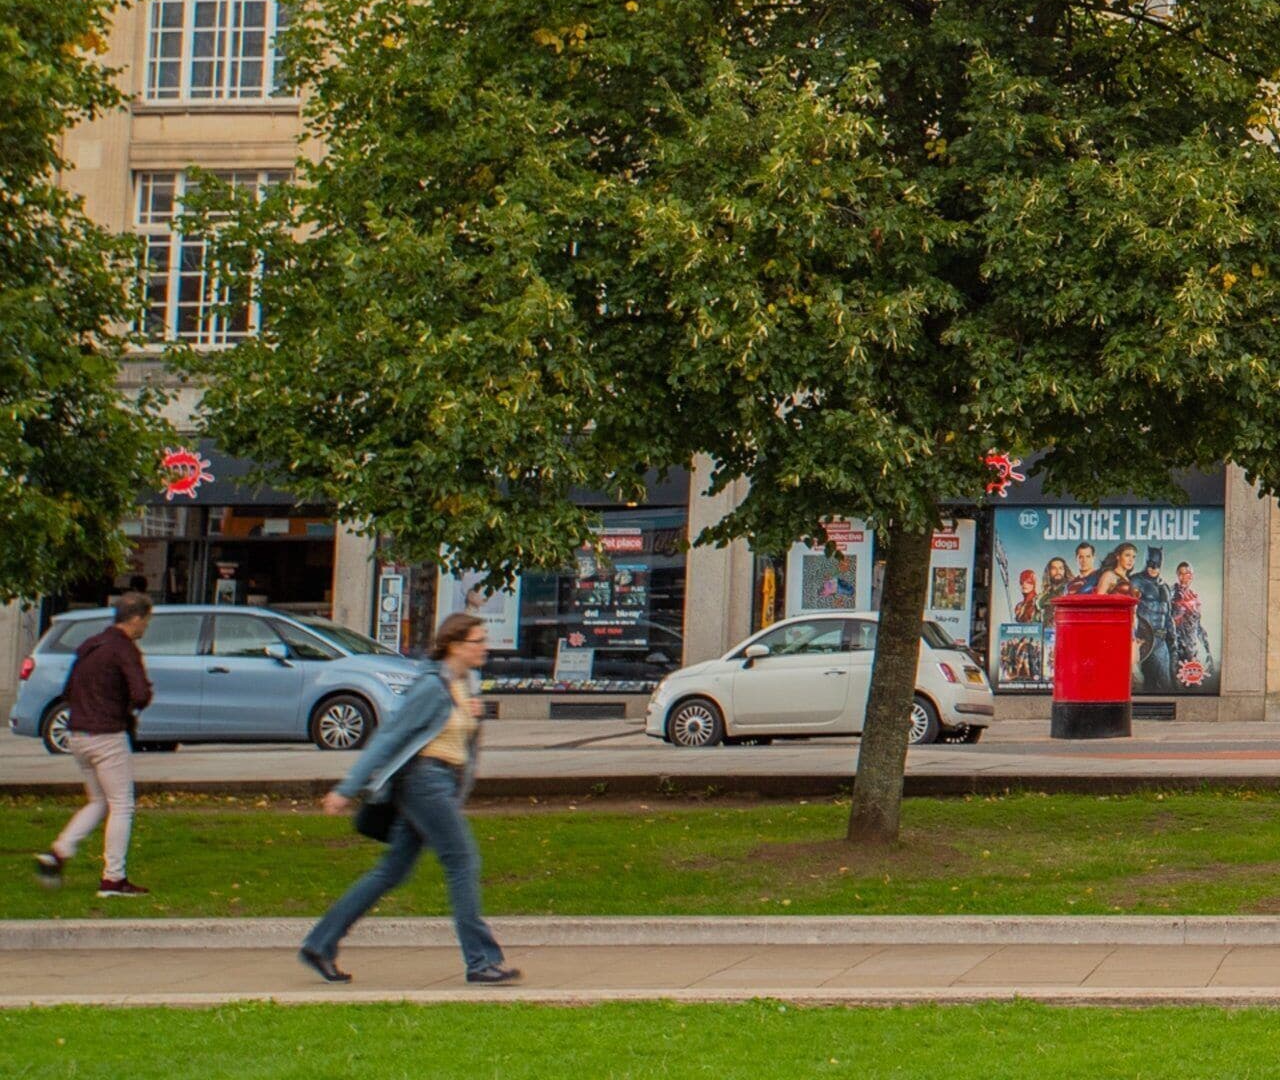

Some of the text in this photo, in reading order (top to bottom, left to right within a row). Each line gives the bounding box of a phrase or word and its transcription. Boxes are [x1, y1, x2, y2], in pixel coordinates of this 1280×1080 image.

[1043, 508, 1200, 540] JUSTICE LEAGUE
[935, 539, 958, 550] dogs
